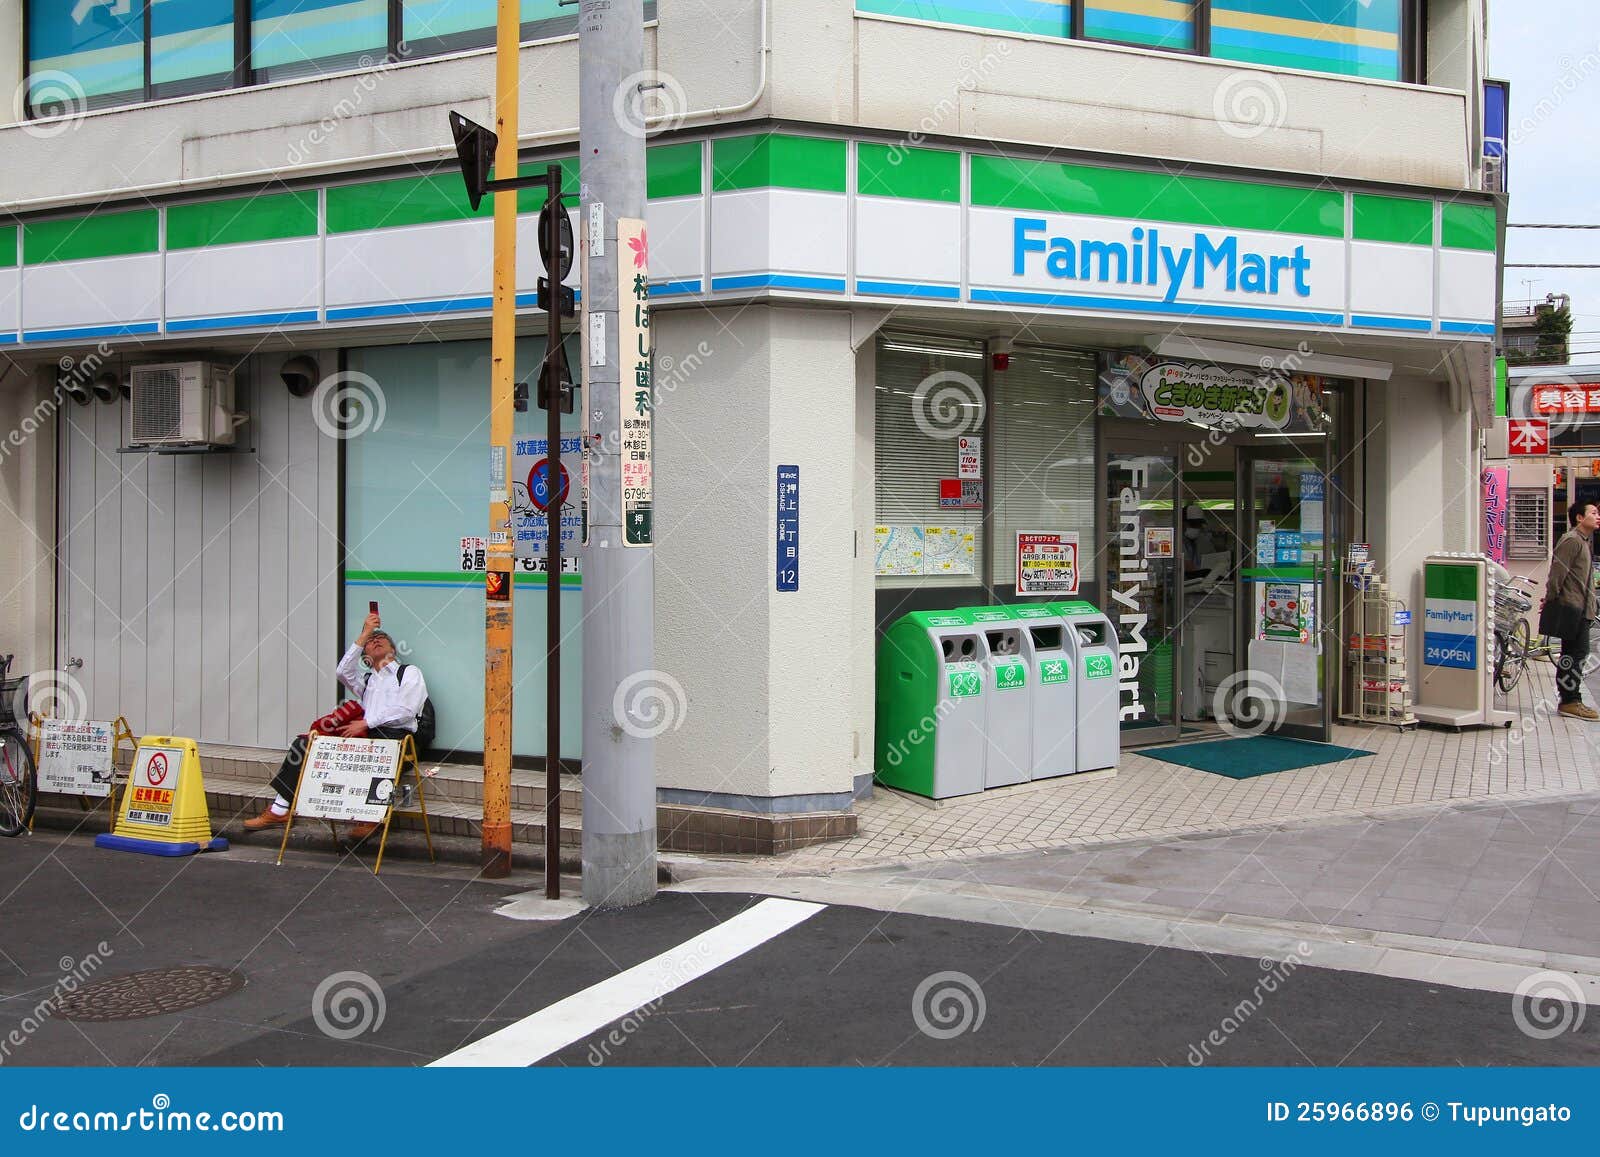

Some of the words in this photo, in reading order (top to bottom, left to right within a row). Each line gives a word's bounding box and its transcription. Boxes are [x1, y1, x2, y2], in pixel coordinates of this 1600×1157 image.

[1013, 217, 1311, 303] FamilyMart
[516, 438, 581, 456] 放置禁区域
[1511, 421, 1546, 453] 本
[786, 483, 797, 558] 押上一丁目
[781, 570, 795, 583] 12
[1111, 462, 1148, 721] FamilyMart
[1426, 609, 1473, 623] FamilyMart
